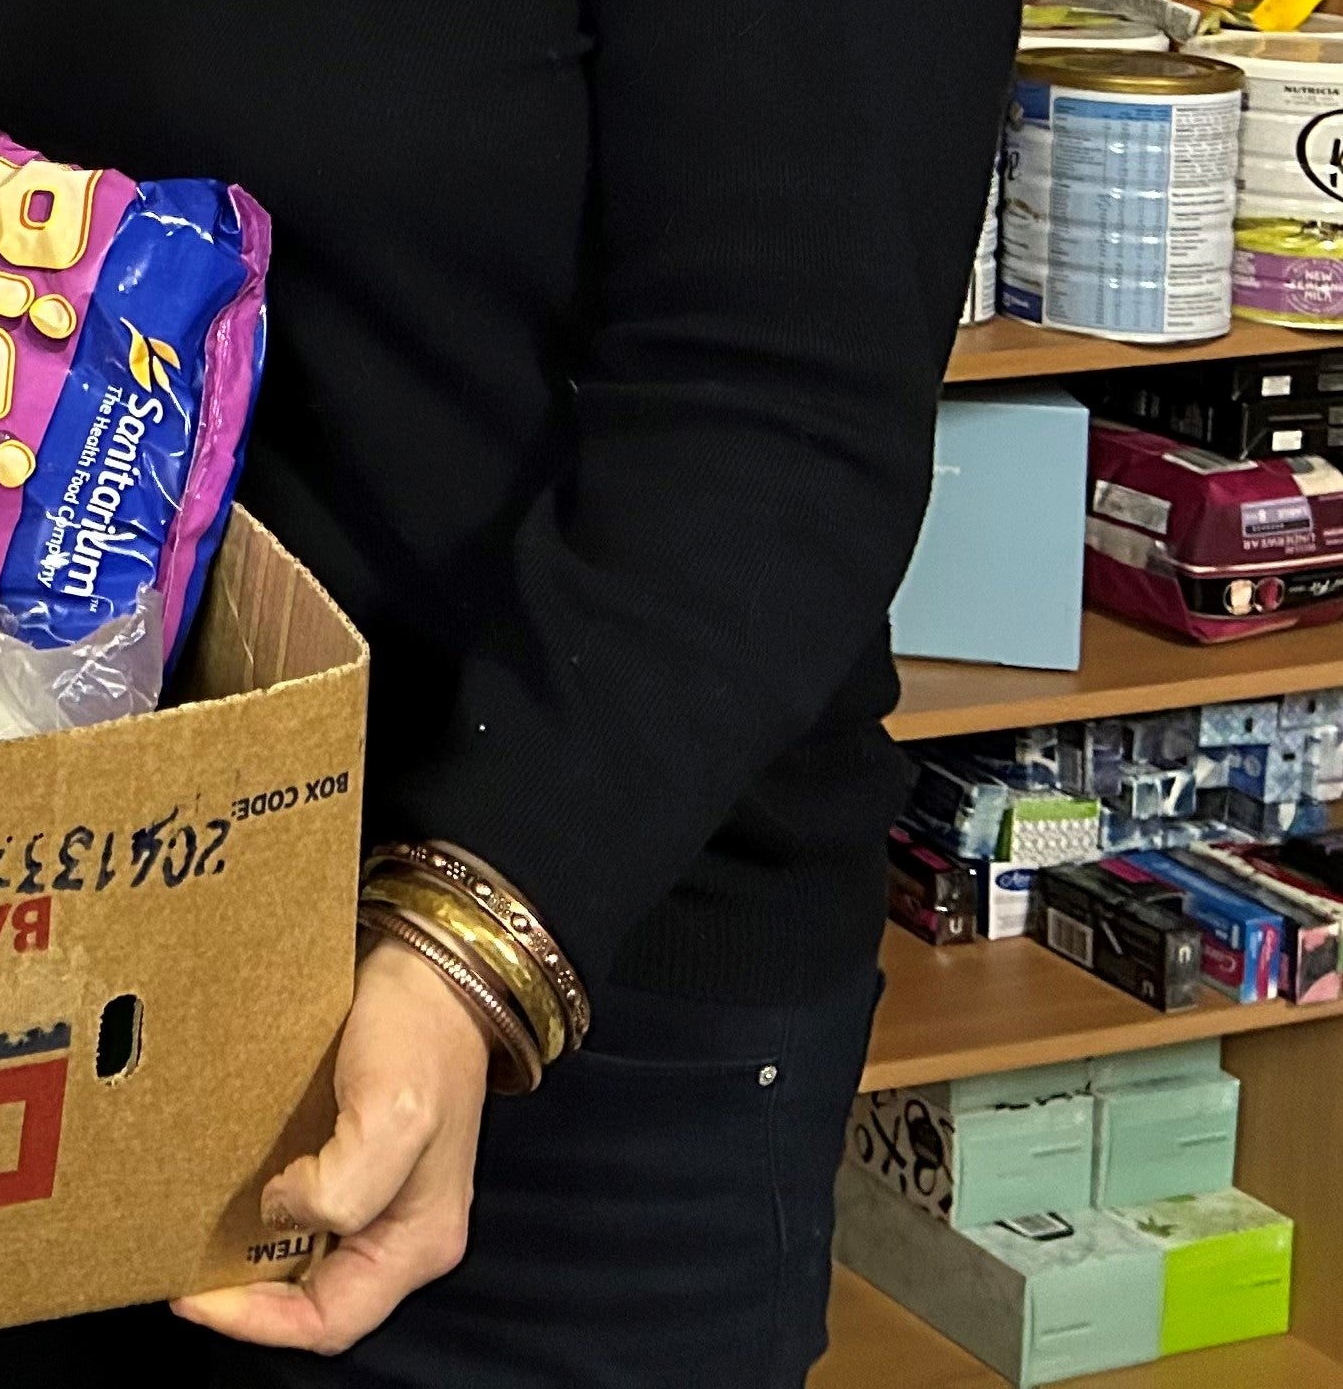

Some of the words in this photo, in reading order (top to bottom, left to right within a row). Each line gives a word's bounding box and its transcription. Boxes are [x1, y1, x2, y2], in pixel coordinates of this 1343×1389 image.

[95, 385, 123, 419] The
[85, 417, 114, 470] Health
[61, 393, 165, 600] Sanitarium
[67, 467, 95, 505] Food
[36, 502, 76, 590] Company
[229, 782, 301, 823] CODE:
[304, 770, 351, 801] BOX
[246, 1232, 316, 1266] ITEM:
